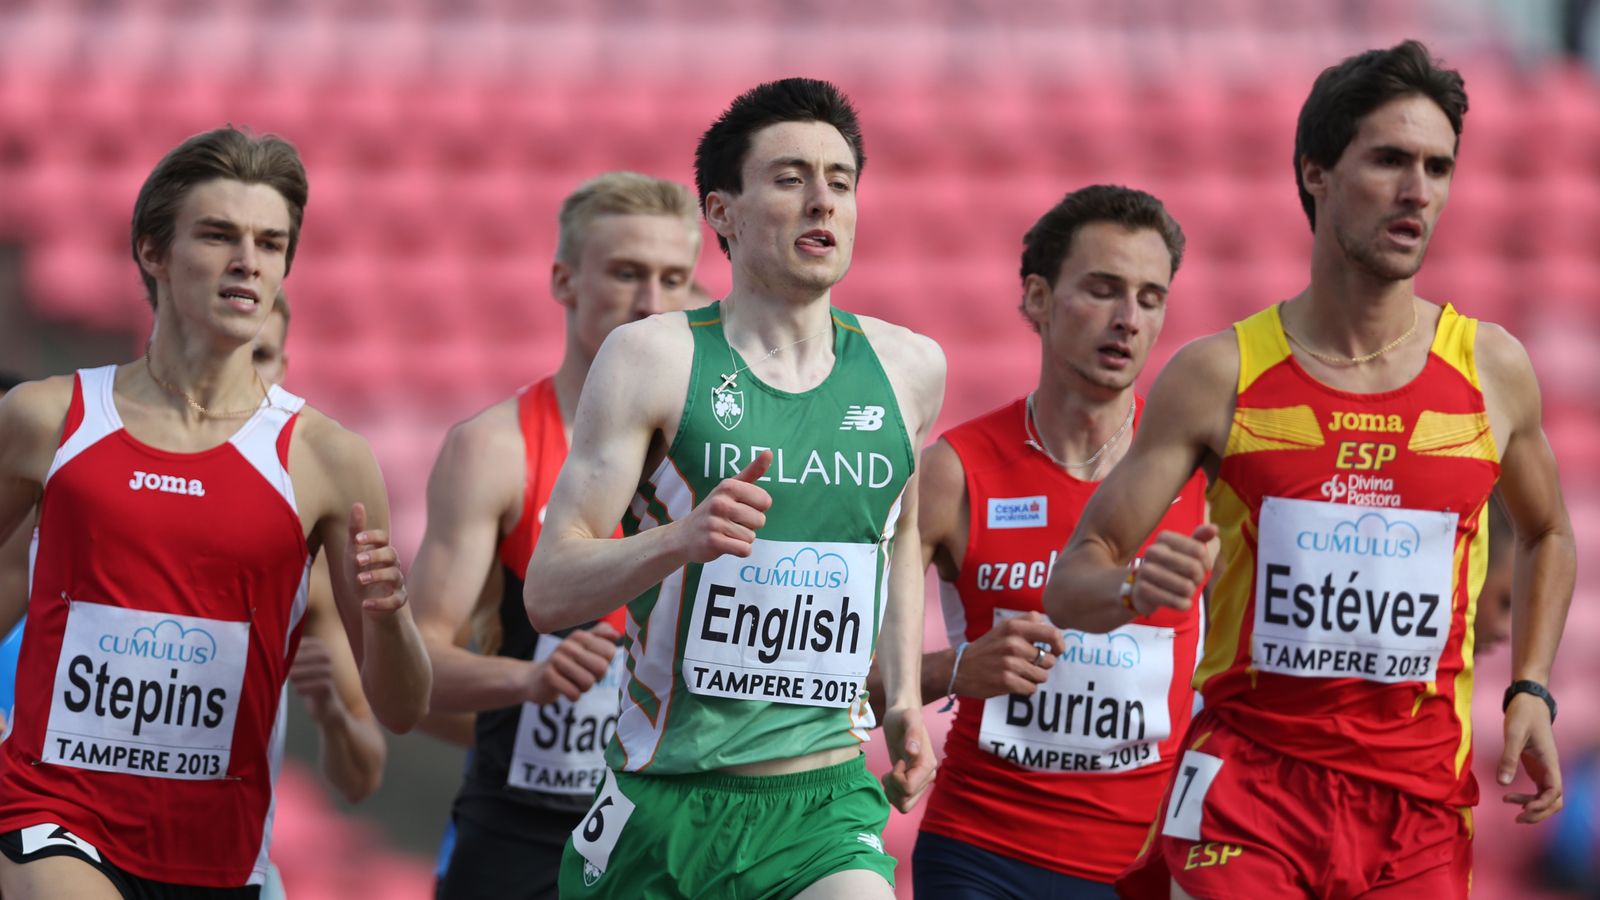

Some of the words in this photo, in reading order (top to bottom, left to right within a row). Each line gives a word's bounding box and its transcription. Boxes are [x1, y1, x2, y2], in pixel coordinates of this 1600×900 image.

[703, 442, 894, 488] IRELAND
[1336, 441, 1397, 471] ESP
[1347, 490, 1401, 507] Pastora
[1348, 474, 1394, 491] Divina
[1296, 531, 1412, 559] CUMULUS
[739, 564, 842, 589] CUMULUS
[1263, 563, 1440, 638] Estévez
[700, 583, 861, 664] English
[98, 633, 209, 665] CUMULUS
[1263, 642, 1378, 675] TAMPERE
[1384, 655, 1431, 678] 2013
[63, 654, 227, 736] Stepins
[694, 666, 804, 699] TAMPERE
[810, 679, 858, 703] 2013
[1006, 681, 1145, 740] Burian
[56, 737, 170, 773] TAMPERE
[174, 752, 221, 776] 2013
[990, 741, 1101, 771] TAMPERE
[1108, 742, 1150, 769] 2013
[583, 795, 614, 843] 6
[1183, 842, 1243, 871] ESP
